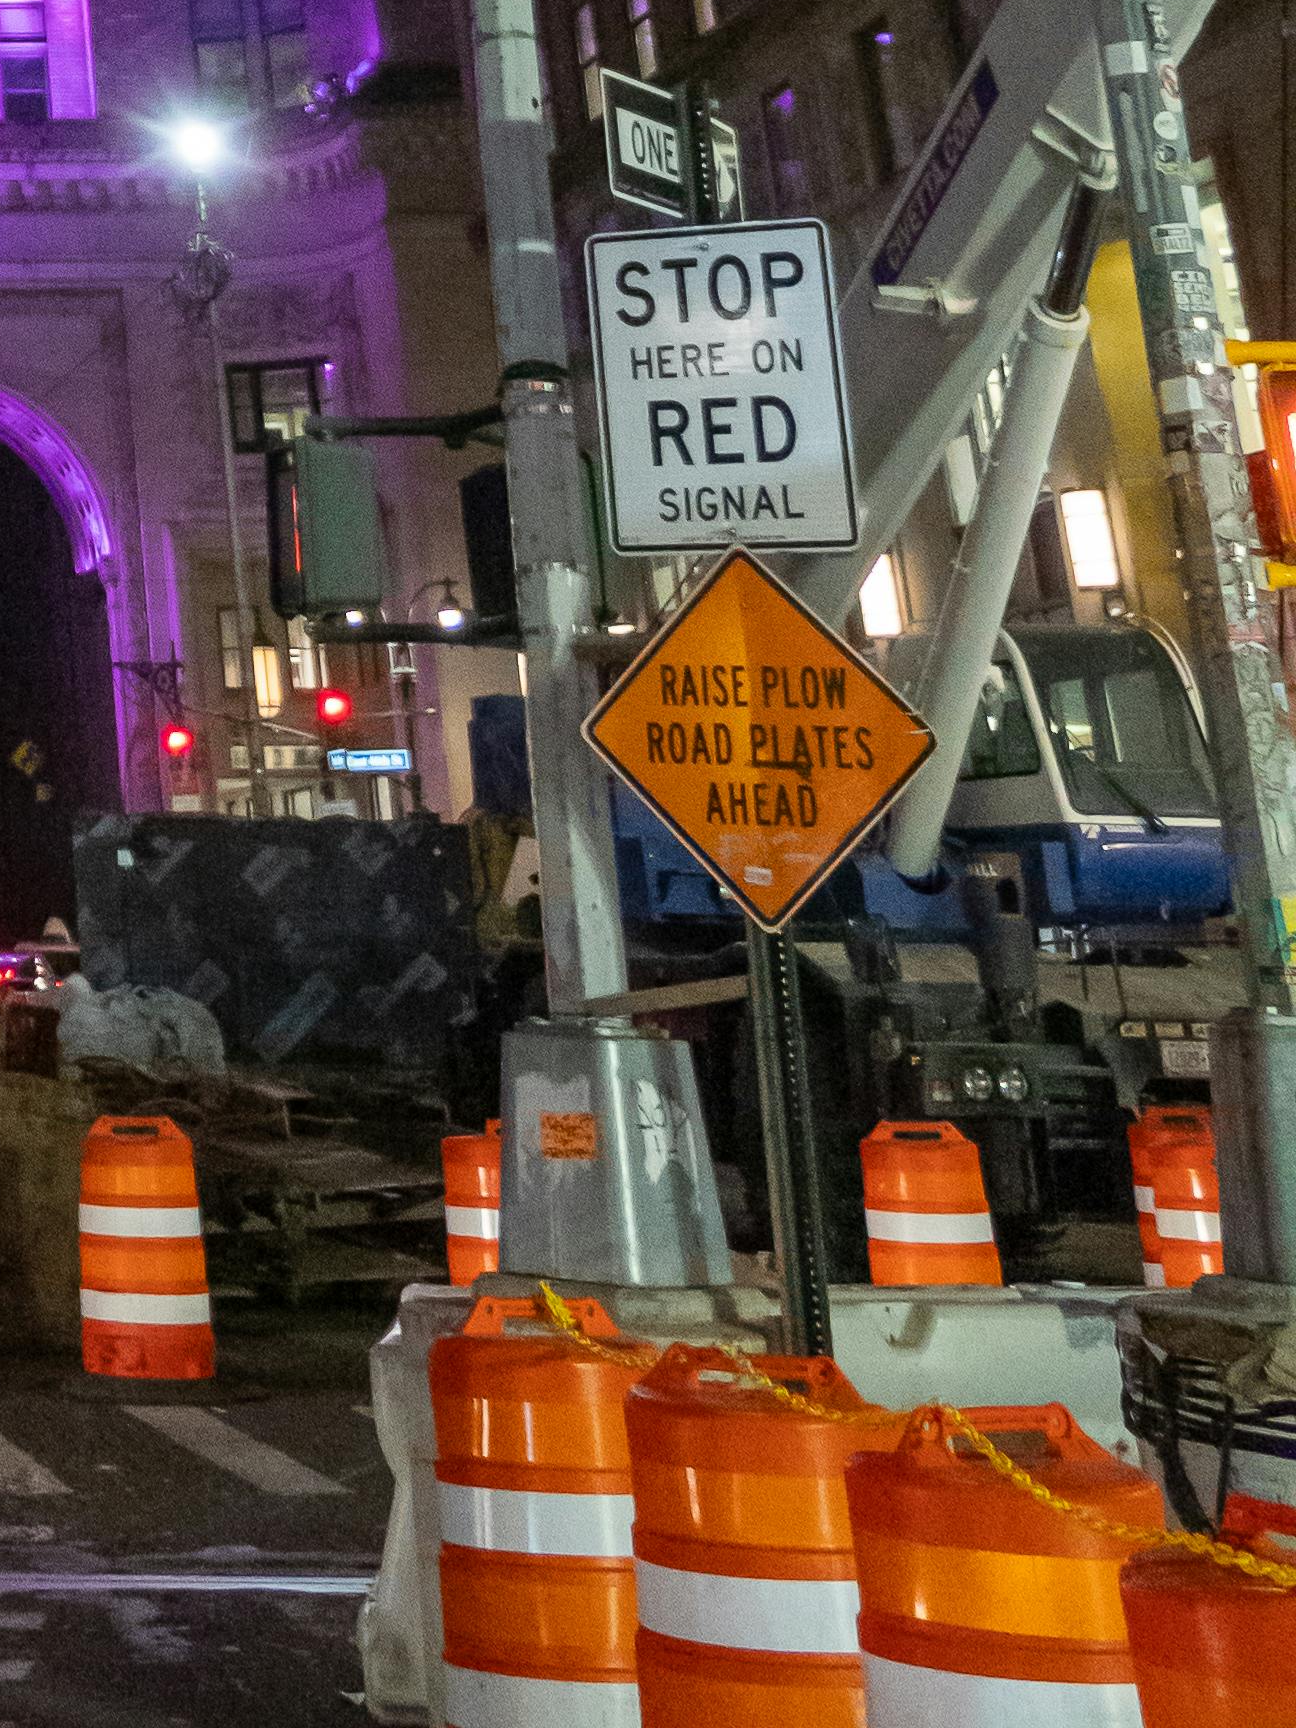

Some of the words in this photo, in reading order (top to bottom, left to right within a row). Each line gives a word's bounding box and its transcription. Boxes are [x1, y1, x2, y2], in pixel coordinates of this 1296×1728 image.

[632, 120, 678, 176] ONE
[616, 251, 805, 328] STOP
[630, 344, 731, 380] HERE
[752, 339, 804, 375] ON
[649, 396, 797, 467] RED
[659, 485, 806, 522] SIGNAL
[660, 664, 748, 708] RAISE
[761, 667, 847, 710] PLOW
[647, 721, 732, 765] ROAD
[750, 724, 874, 771] PLATES
[706, 781, 819, 828] AHEAD
